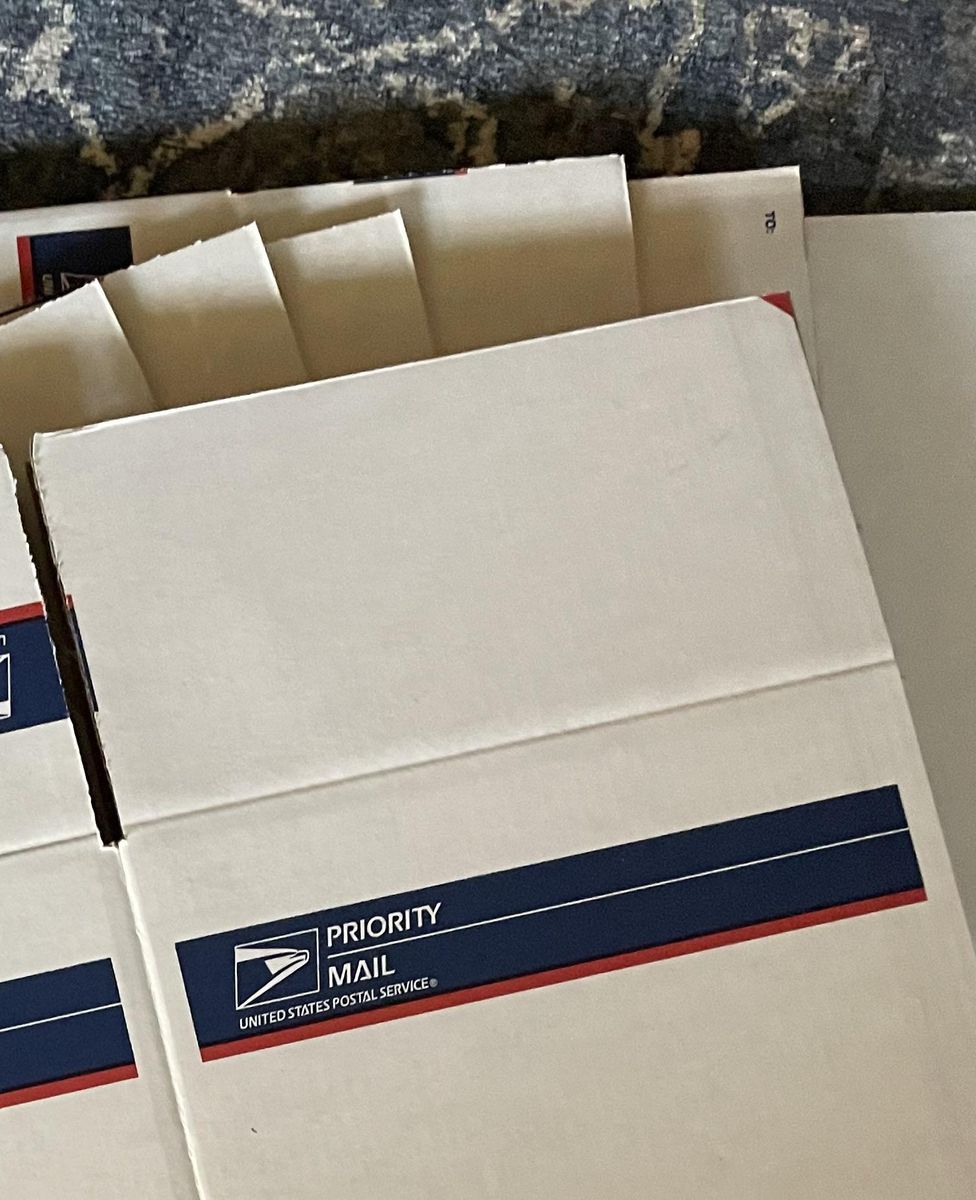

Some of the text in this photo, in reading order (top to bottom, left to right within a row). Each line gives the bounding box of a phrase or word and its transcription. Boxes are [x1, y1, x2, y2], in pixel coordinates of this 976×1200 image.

[327, 902, 441, 947] PRIORITY
[329, 955, 395, 988] MAIL
[239, 1009, 285, 1029] UNITED
[288, 1001, 330, 1019] STATES
[333, 990, 377, 1009] POSTAL
